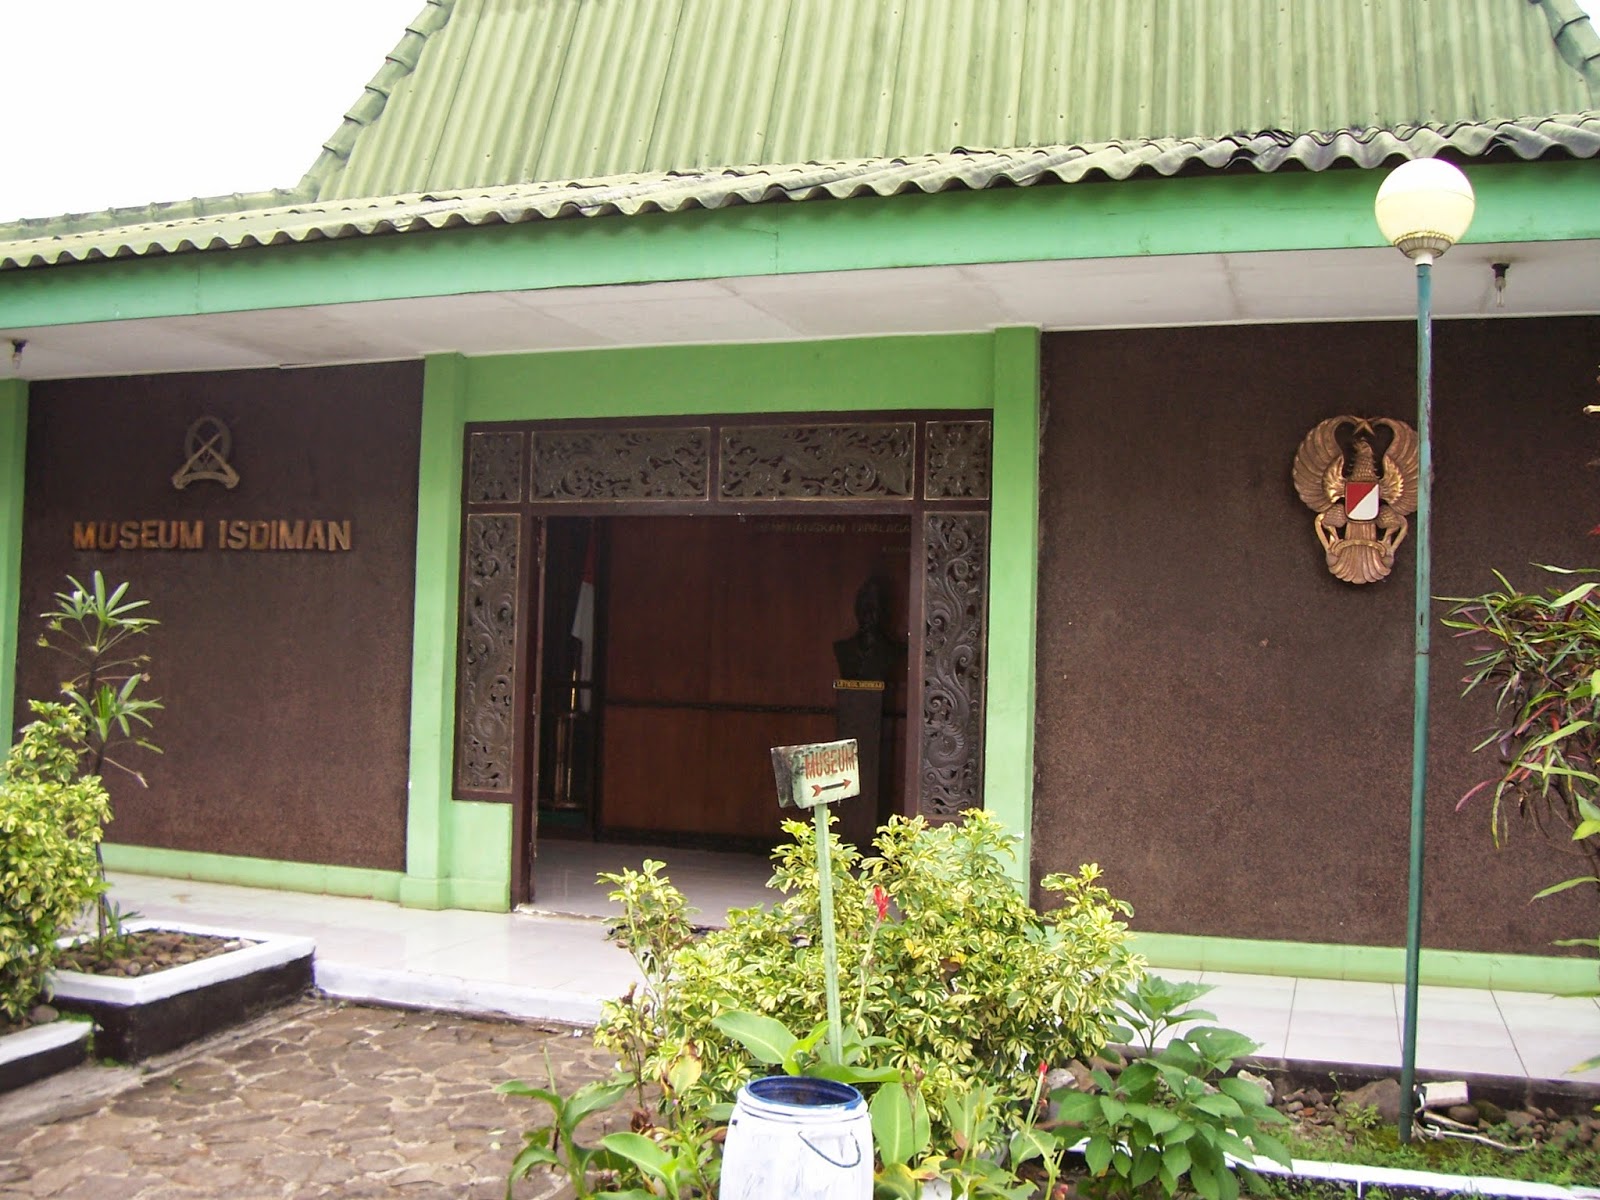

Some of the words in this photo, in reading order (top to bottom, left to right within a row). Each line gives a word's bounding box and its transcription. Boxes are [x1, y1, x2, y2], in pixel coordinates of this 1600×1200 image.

[73, 520, 205, 550] MUSEUM
[218, 519, 351, 551] ISDIMAN
[804, 746, 856, 780] MUSEUM
